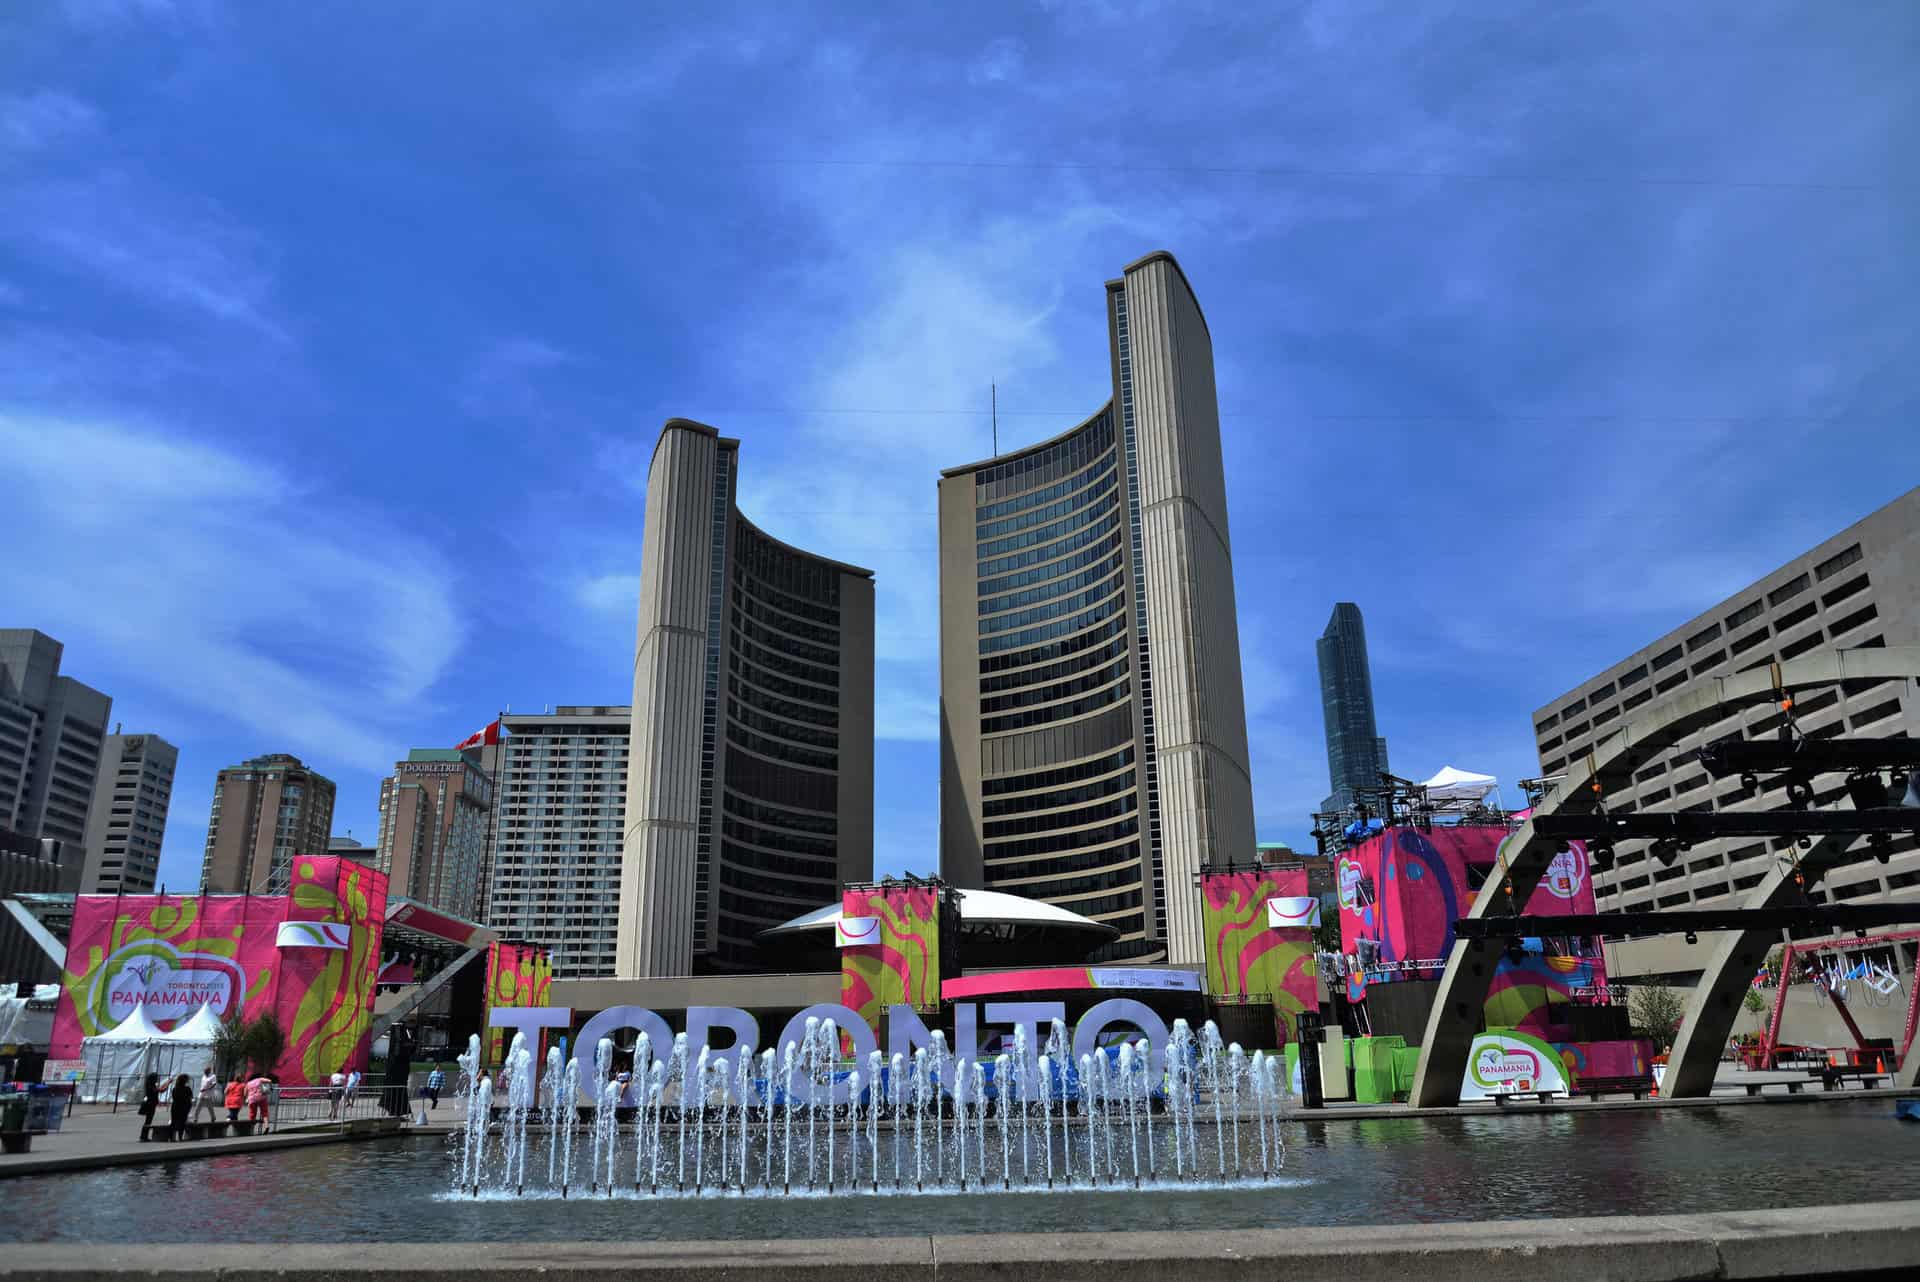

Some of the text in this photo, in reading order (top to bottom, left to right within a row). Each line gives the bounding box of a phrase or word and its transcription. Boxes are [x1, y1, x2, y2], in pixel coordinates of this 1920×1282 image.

[112, 991, 222, 1006] PANAMANIA
[488, 998, 1171, 1107] TORONTO
[1480, 1063, 1532, 1074] PANAMANIA
